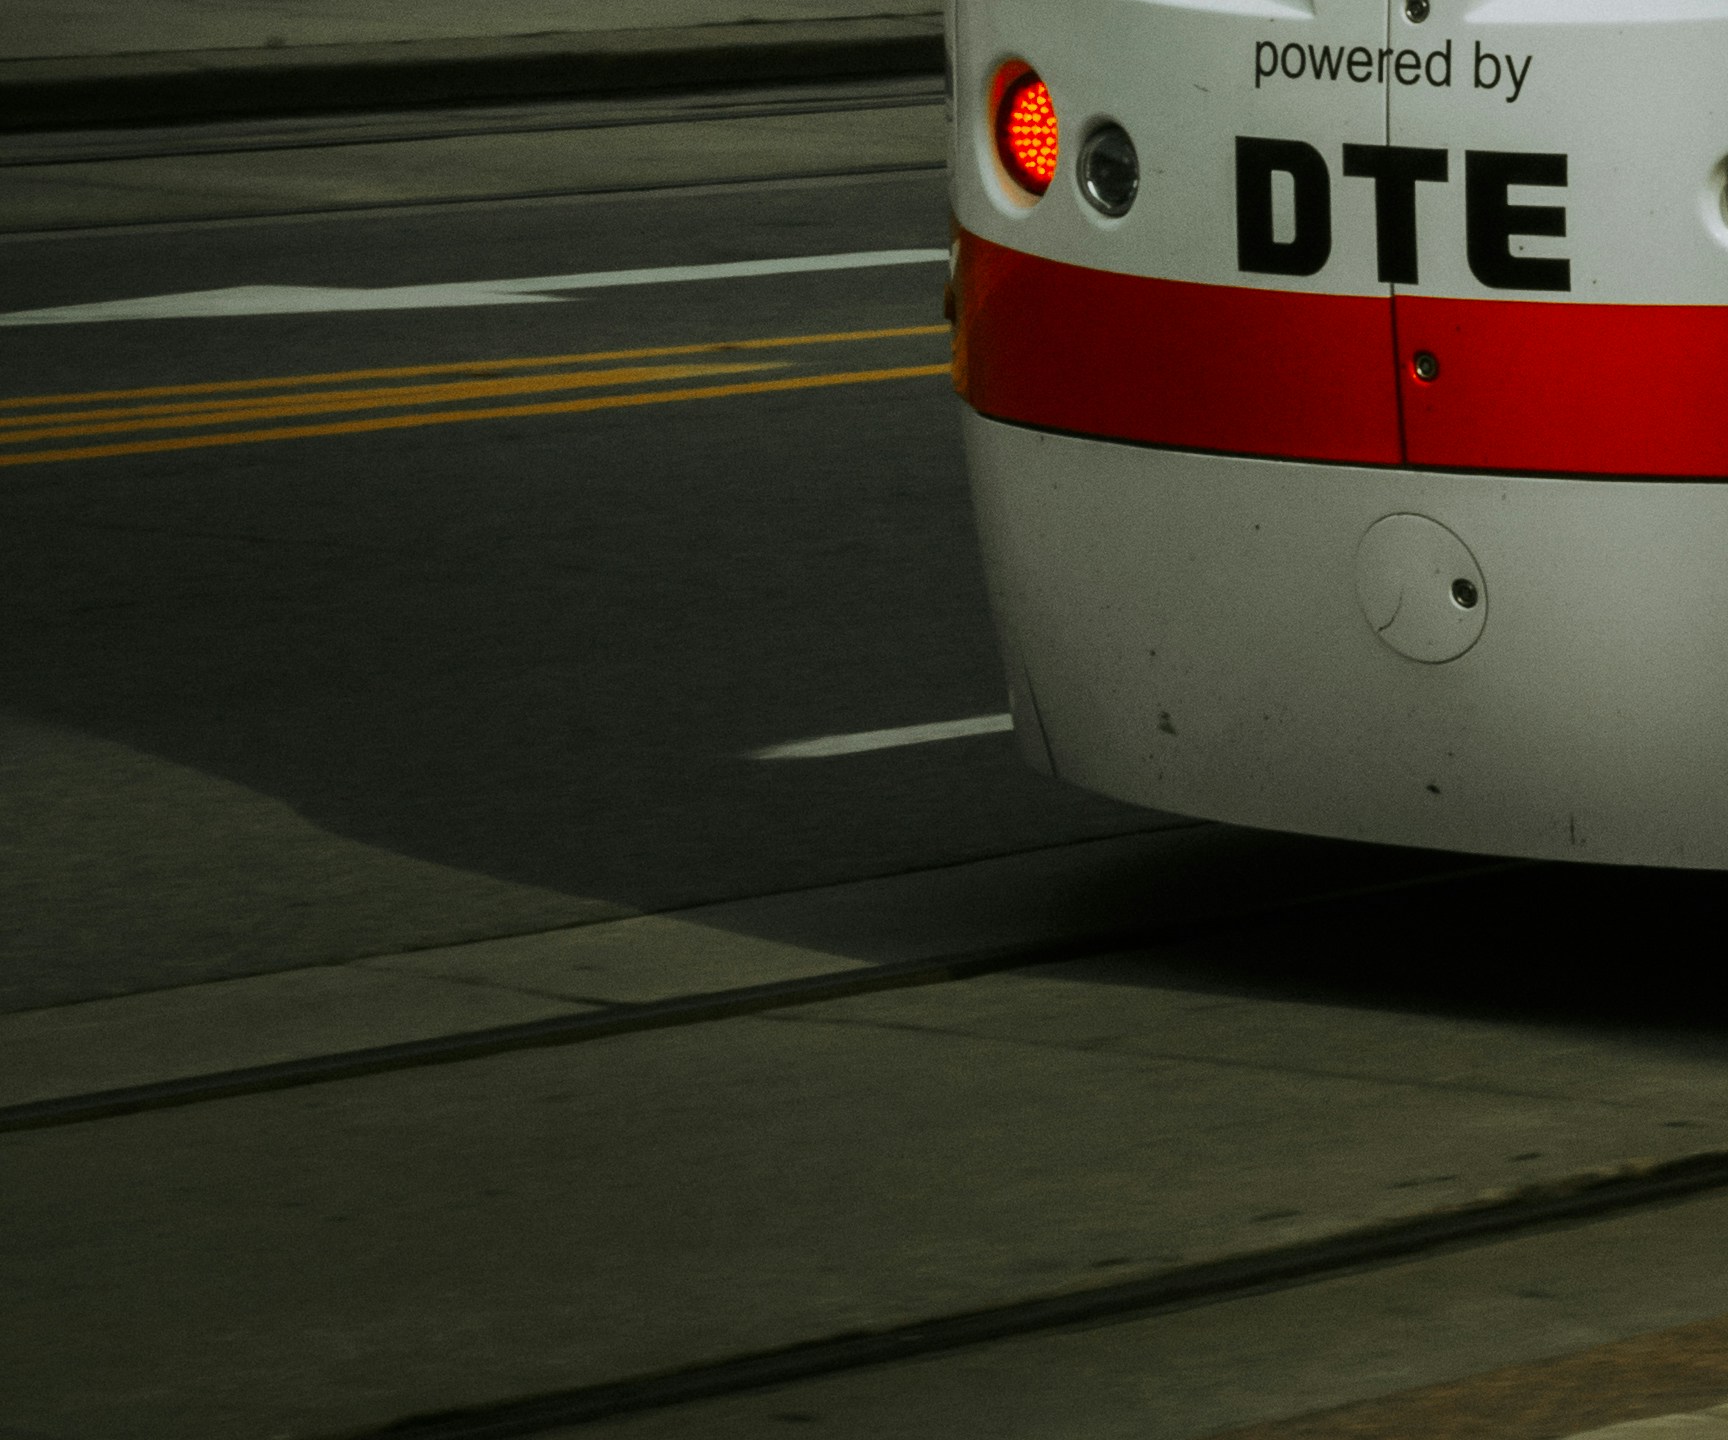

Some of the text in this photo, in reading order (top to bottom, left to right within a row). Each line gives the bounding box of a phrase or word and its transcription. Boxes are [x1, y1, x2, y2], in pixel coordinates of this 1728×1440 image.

[1254, 38, 1534, 104] powered by
[1234, 134, 1572, 293] DTE
